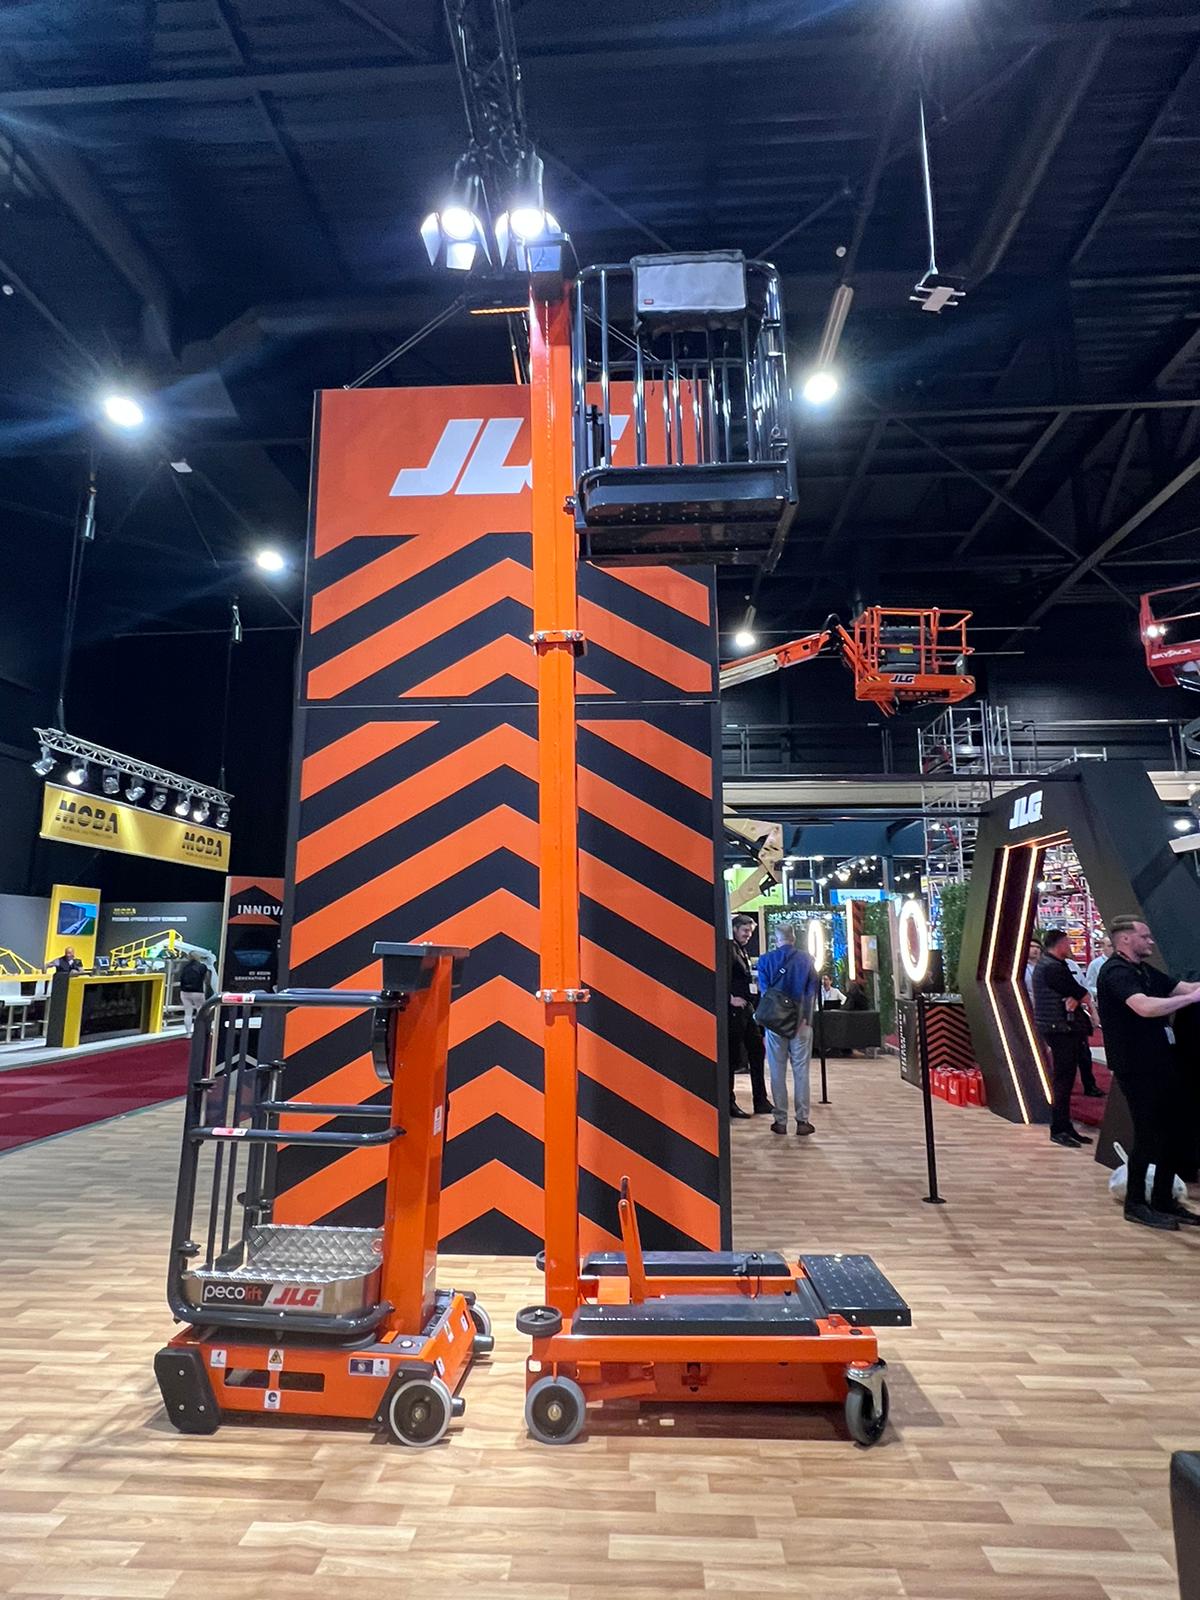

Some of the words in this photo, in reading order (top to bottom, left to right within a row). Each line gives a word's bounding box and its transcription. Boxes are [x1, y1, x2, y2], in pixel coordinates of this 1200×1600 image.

[389, 415, 630, 496] JL
[889, 674, 915, 684] JLG
[56, 799, 119, 834] MOBA
[1009, 790, 1043, 830] JLG
[182, 831, 222, 857] MOBA
[203, 1284, 263, 1302] pecolift
[272, 1287, 321, 1307] JLG
